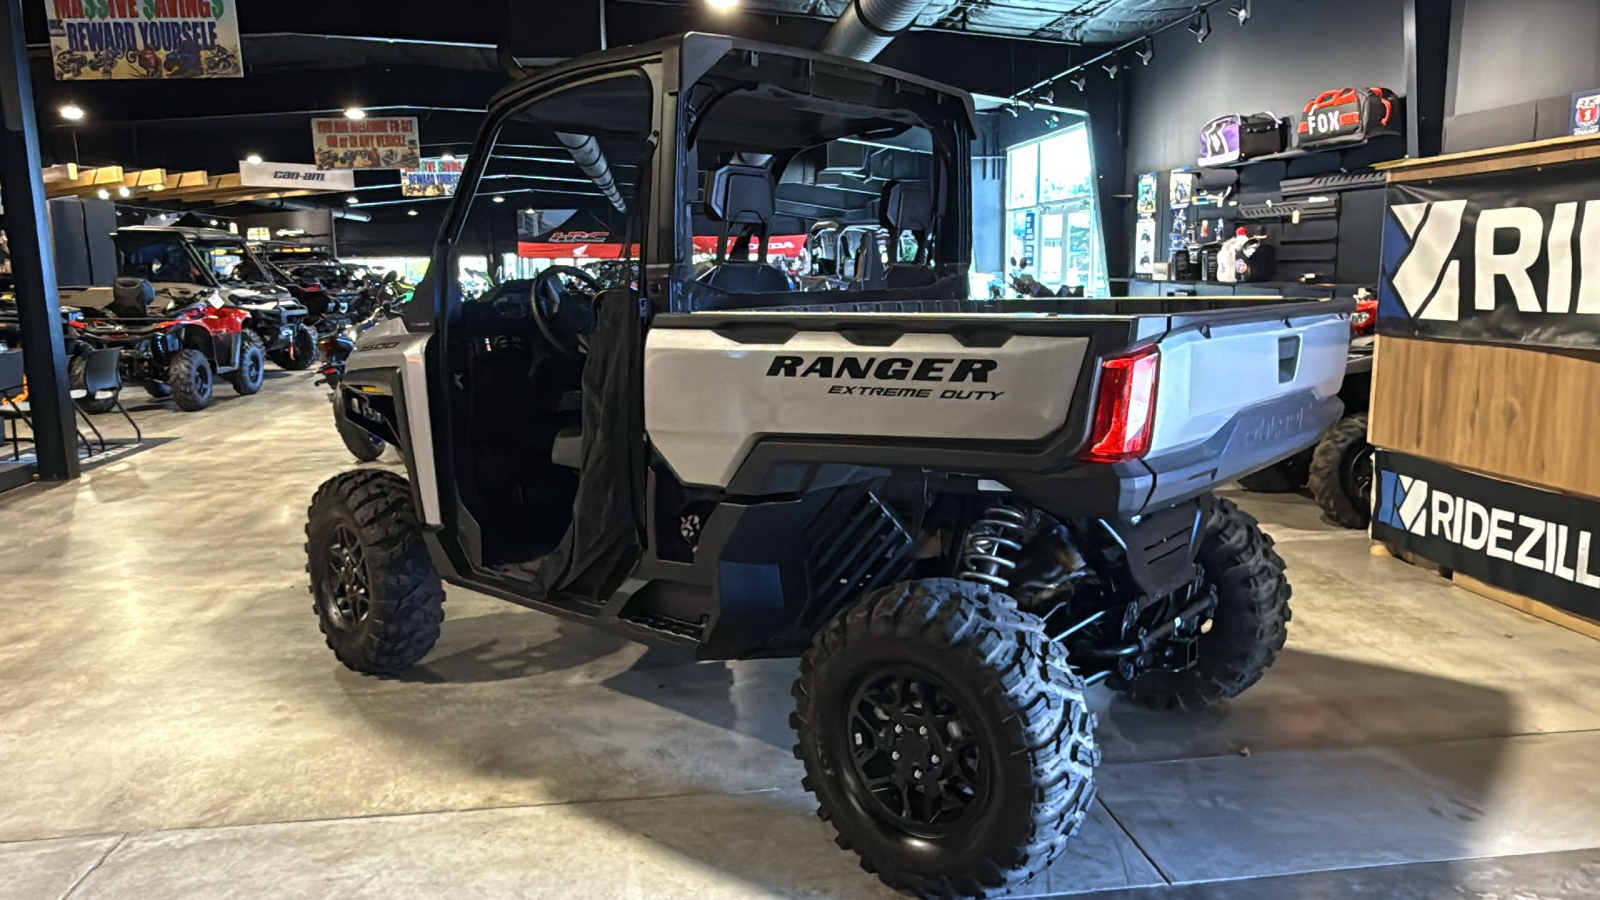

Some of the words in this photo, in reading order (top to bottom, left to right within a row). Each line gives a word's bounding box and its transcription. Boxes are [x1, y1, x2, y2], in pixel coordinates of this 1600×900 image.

[66, 22, 138, 51] REWARD
[139, 21, 218, 51] YOURSELF
[1308, 110, 1340, 135] FOX
[273, 171, 325, 181] can-am
[766, 355, 998, 383] RANGER
[828, 385, 933, 399] EXTREME
[939, 389, 1005, 401] DUTY
